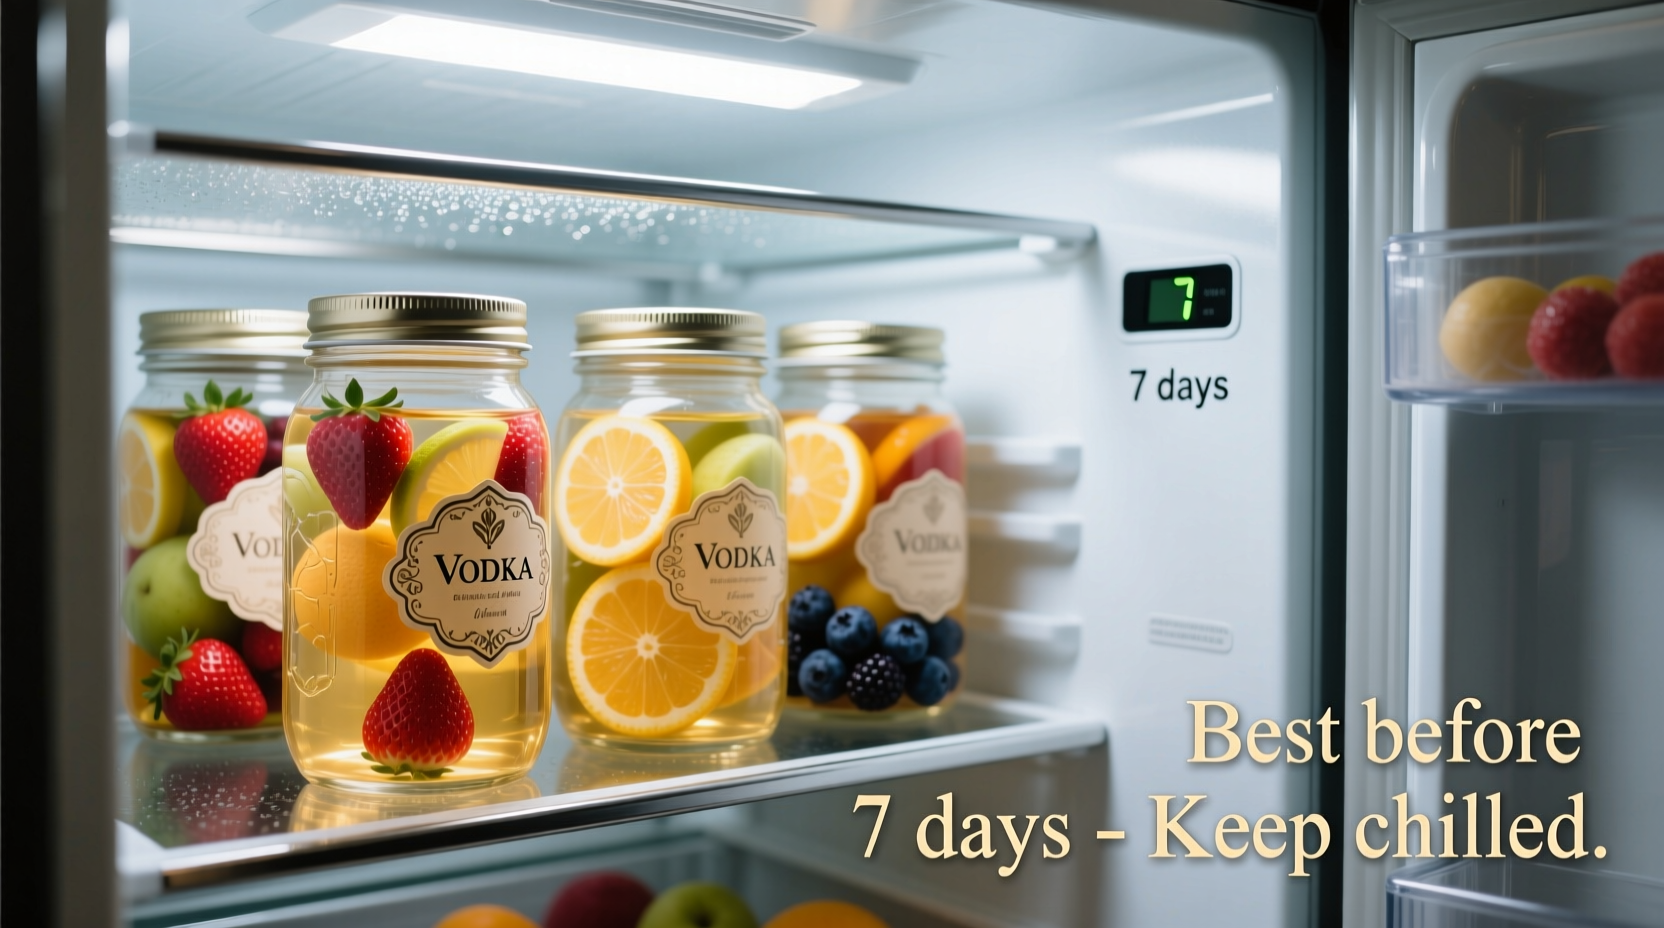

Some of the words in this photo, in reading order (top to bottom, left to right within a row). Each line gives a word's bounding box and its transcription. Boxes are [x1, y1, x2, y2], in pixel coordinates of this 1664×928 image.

[1173, 276, 1195, 321] 7
[1130, 369, 1147, 401] 7
[1157, 367, 1229, 409] days
[232, 531, 282, 558] VOD
[694, 542, 776, 570] VODKA
[894, 528, 963, 554] VODKA
[433, 553, 534, 585] VODKA
